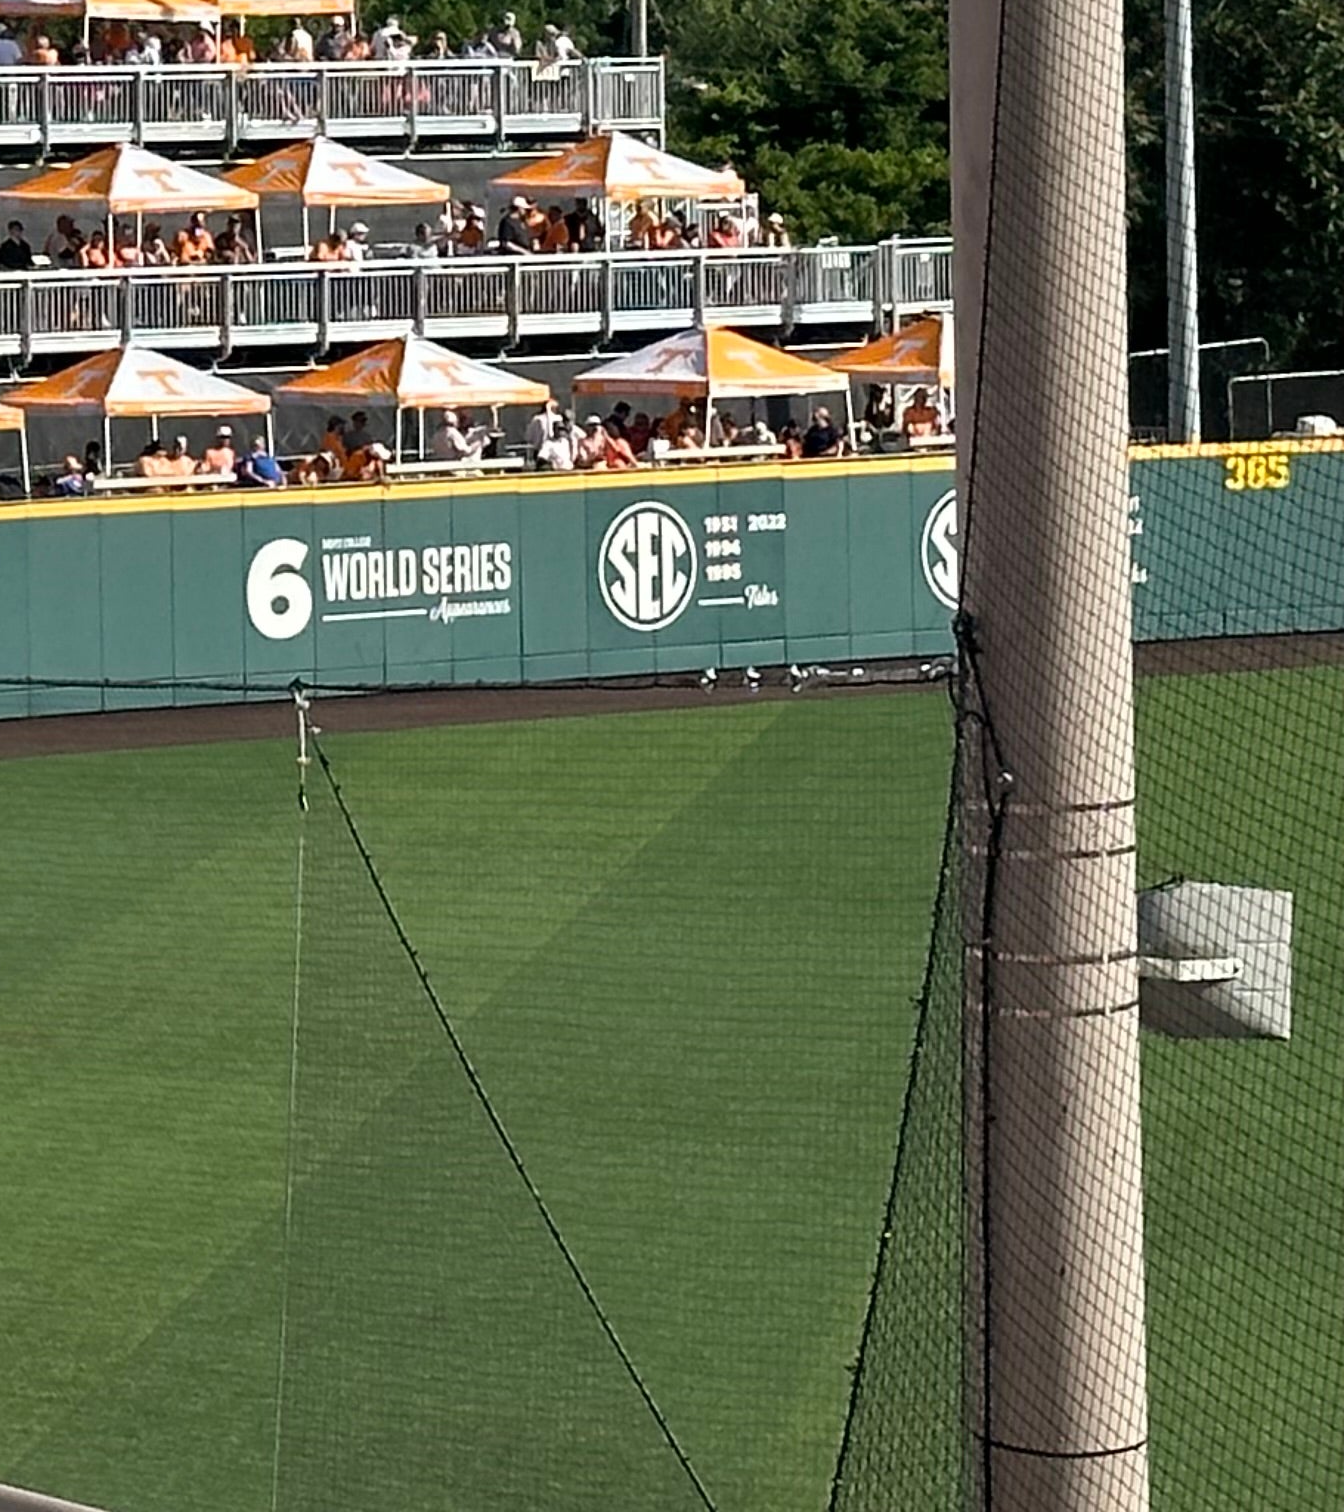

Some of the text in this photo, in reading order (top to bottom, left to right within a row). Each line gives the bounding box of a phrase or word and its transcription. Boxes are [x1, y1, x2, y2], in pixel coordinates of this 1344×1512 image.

[246, 537, 313, 639] 6
[322, 542, 512, 602] WORLD SERIES
[607, 513, 688, 620] SEC
